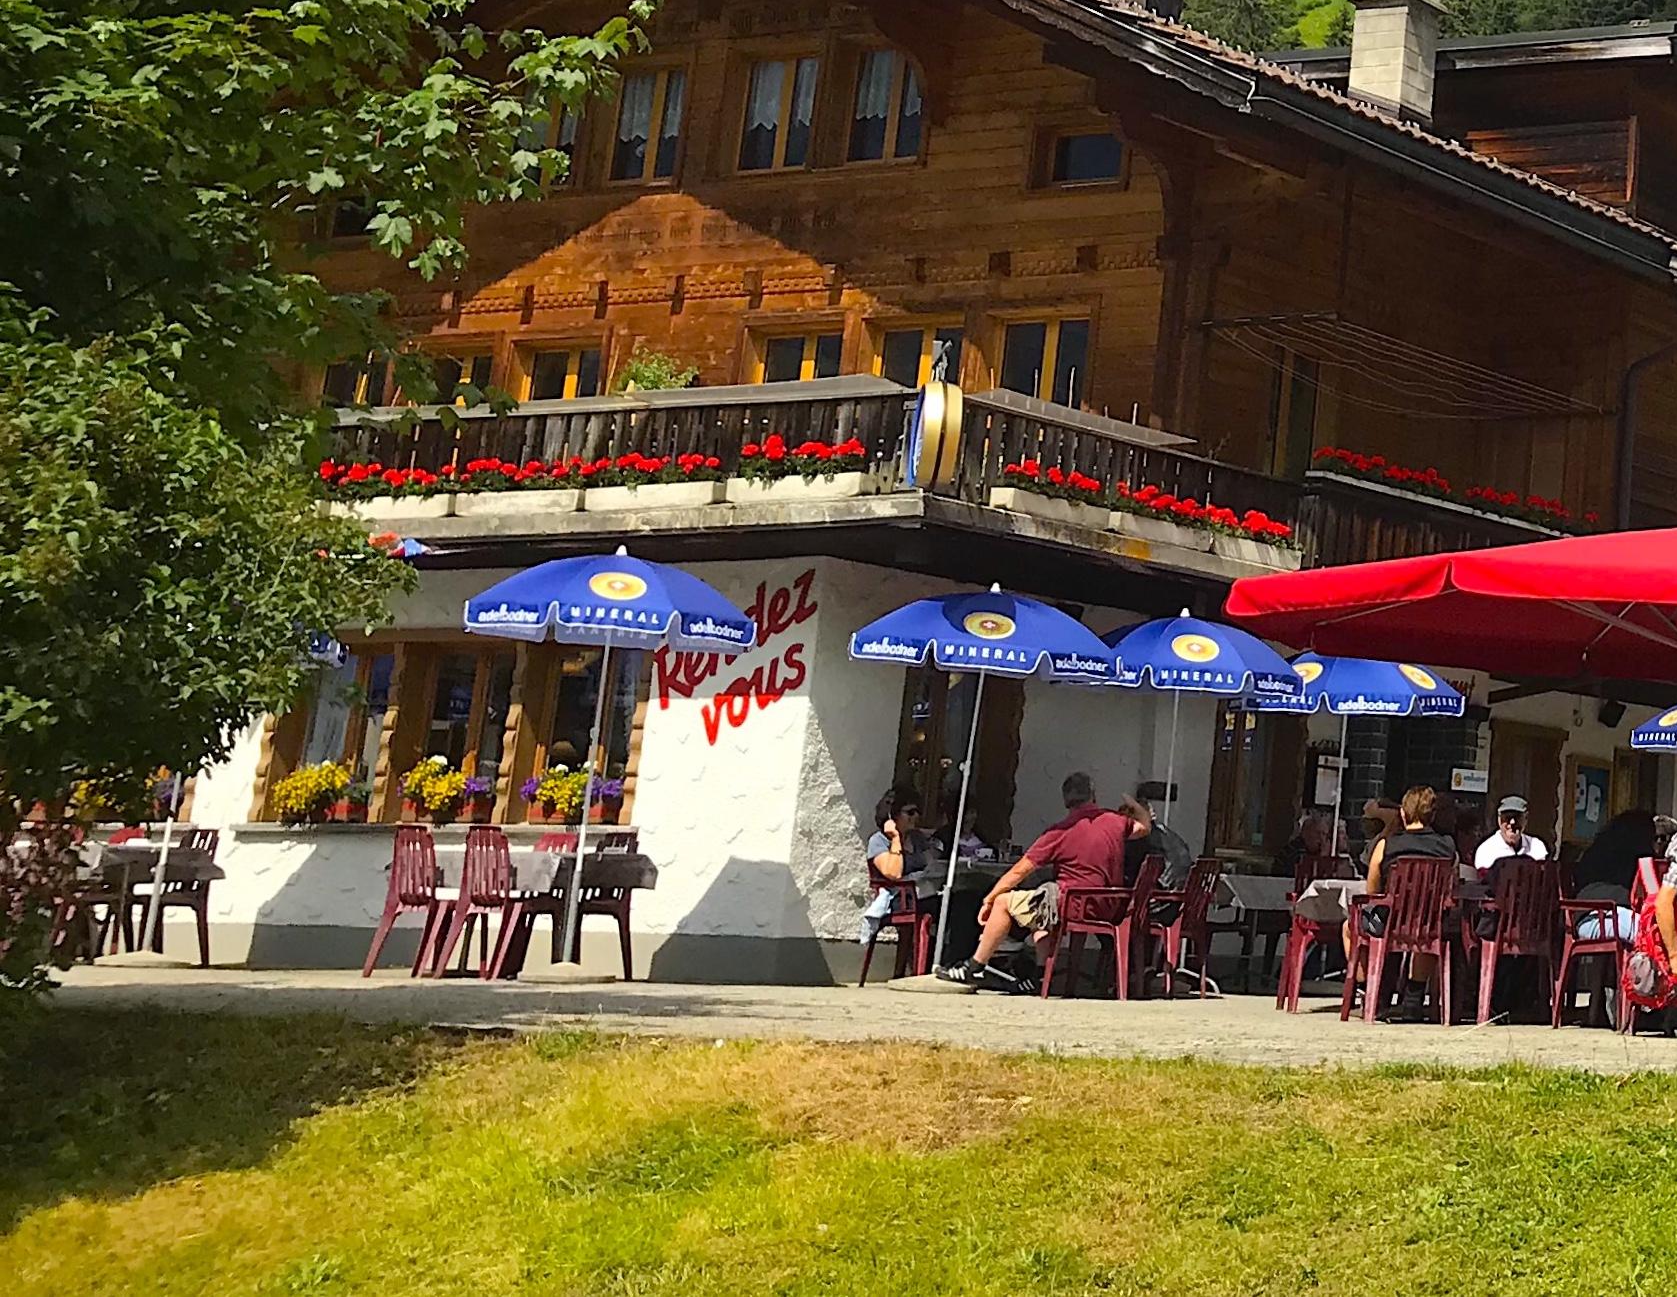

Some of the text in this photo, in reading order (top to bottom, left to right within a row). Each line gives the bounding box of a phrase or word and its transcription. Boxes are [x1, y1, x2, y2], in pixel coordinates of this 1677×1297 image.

[478, 604, 540, 623] adelbodner
[570, 606, 660, 625] MINERAL
[689, 617, 745, 640] adelbodner
[861, 637, 919, 658] adelbodner
[944, 644, 1027, 663] MINERAL
[1055, 653, 1109, 673] adelbodner
[1160, 669, 1234, 684] MINERAL
[701, 643, 805, 746] vous
[1337, 695, 1401, 711] adelbodner
